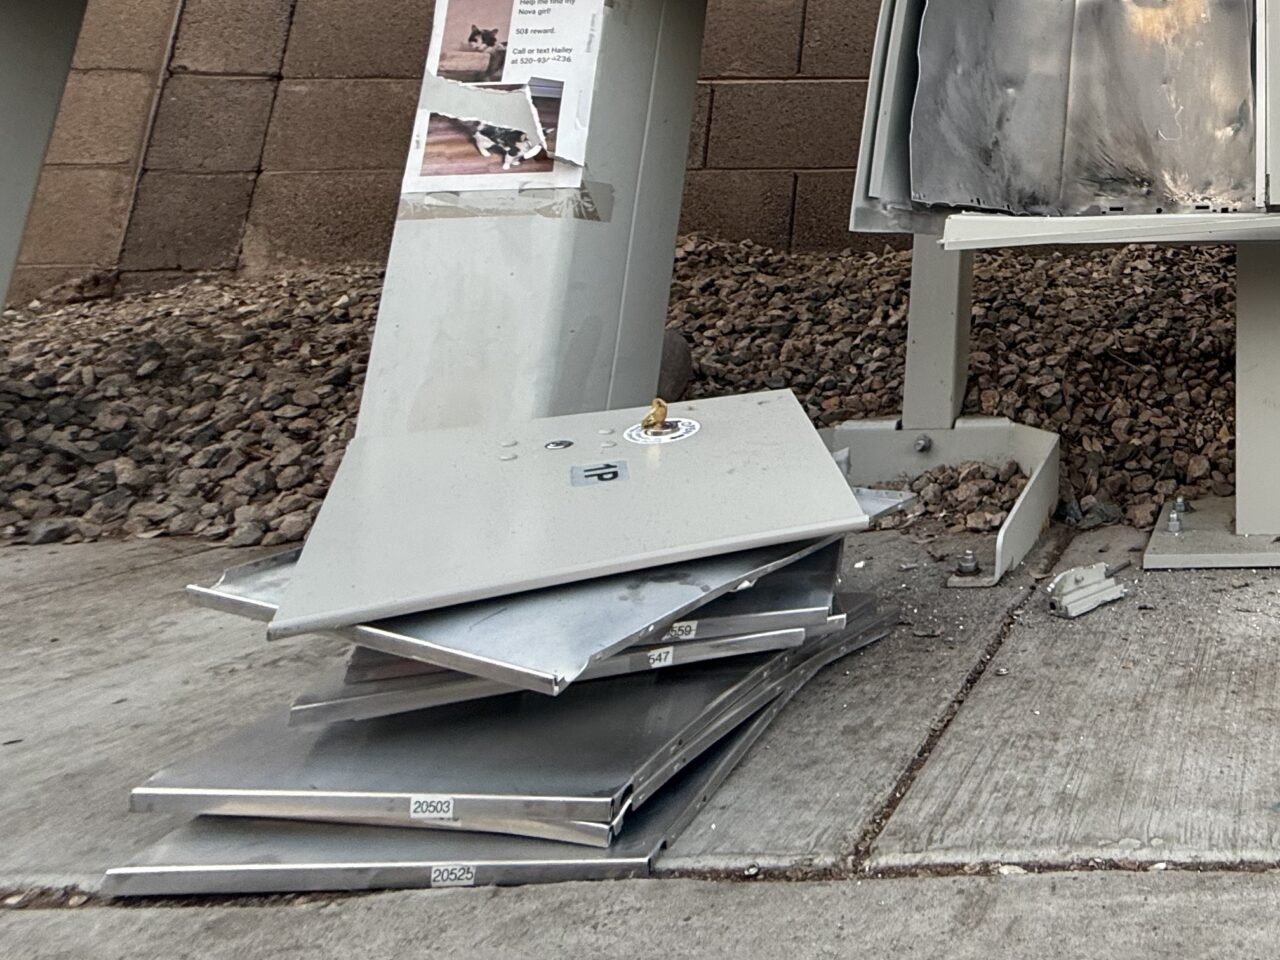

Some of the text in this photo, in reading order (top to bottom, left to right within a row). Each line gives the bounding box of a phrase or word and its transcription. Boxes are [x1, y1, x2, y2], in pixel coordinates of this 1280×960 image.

[551, 46, 573, 54] Hailey
[583, 463, 619, 482] 1P
[413, 800, 451, 814] 20503
[432, 867, 474, 883] 20525
